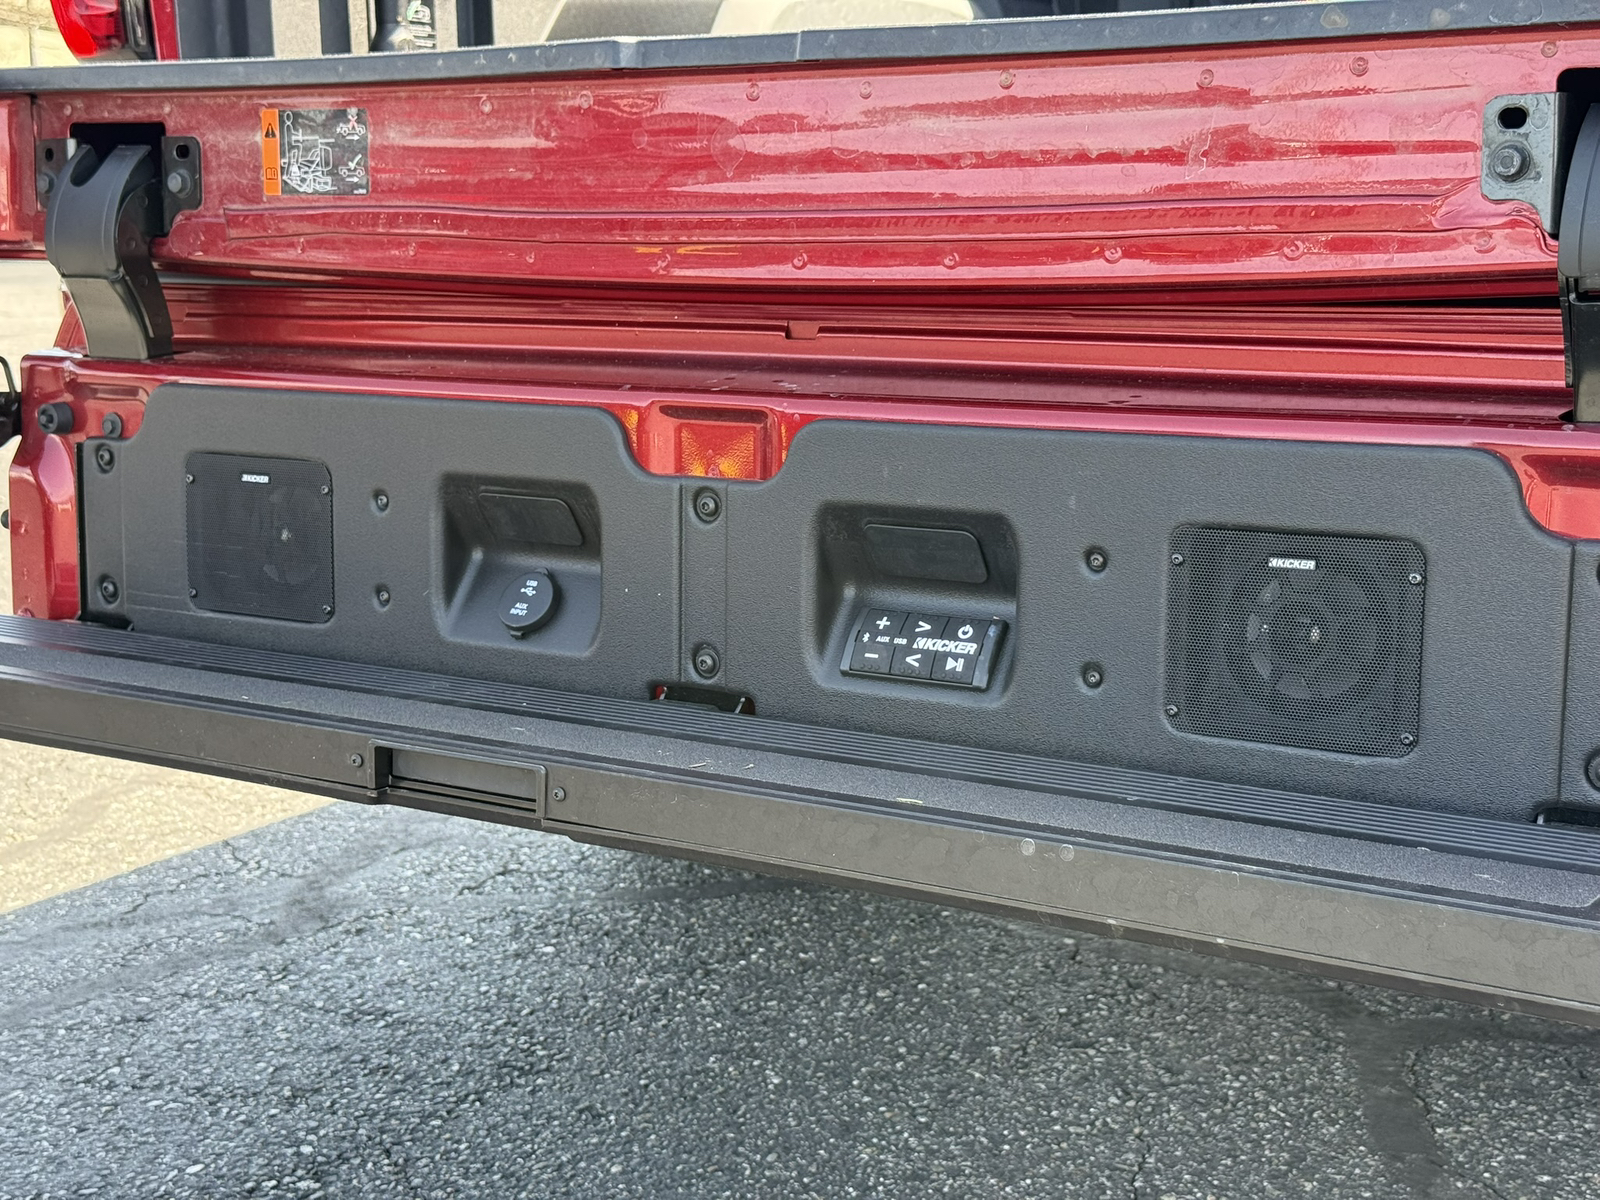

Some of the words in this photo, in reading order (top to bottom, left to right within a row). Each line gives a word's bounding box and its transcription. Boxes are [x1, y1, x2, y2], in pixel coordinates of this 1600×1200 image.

[244, 474, 269, 483] KICKER
[1276, 559, 1315, 570] KICKER
[509, 608, 528, 616] INPUT
[893, 637, 907, 645] USB
[922, 638, 977, 654] KICKER
